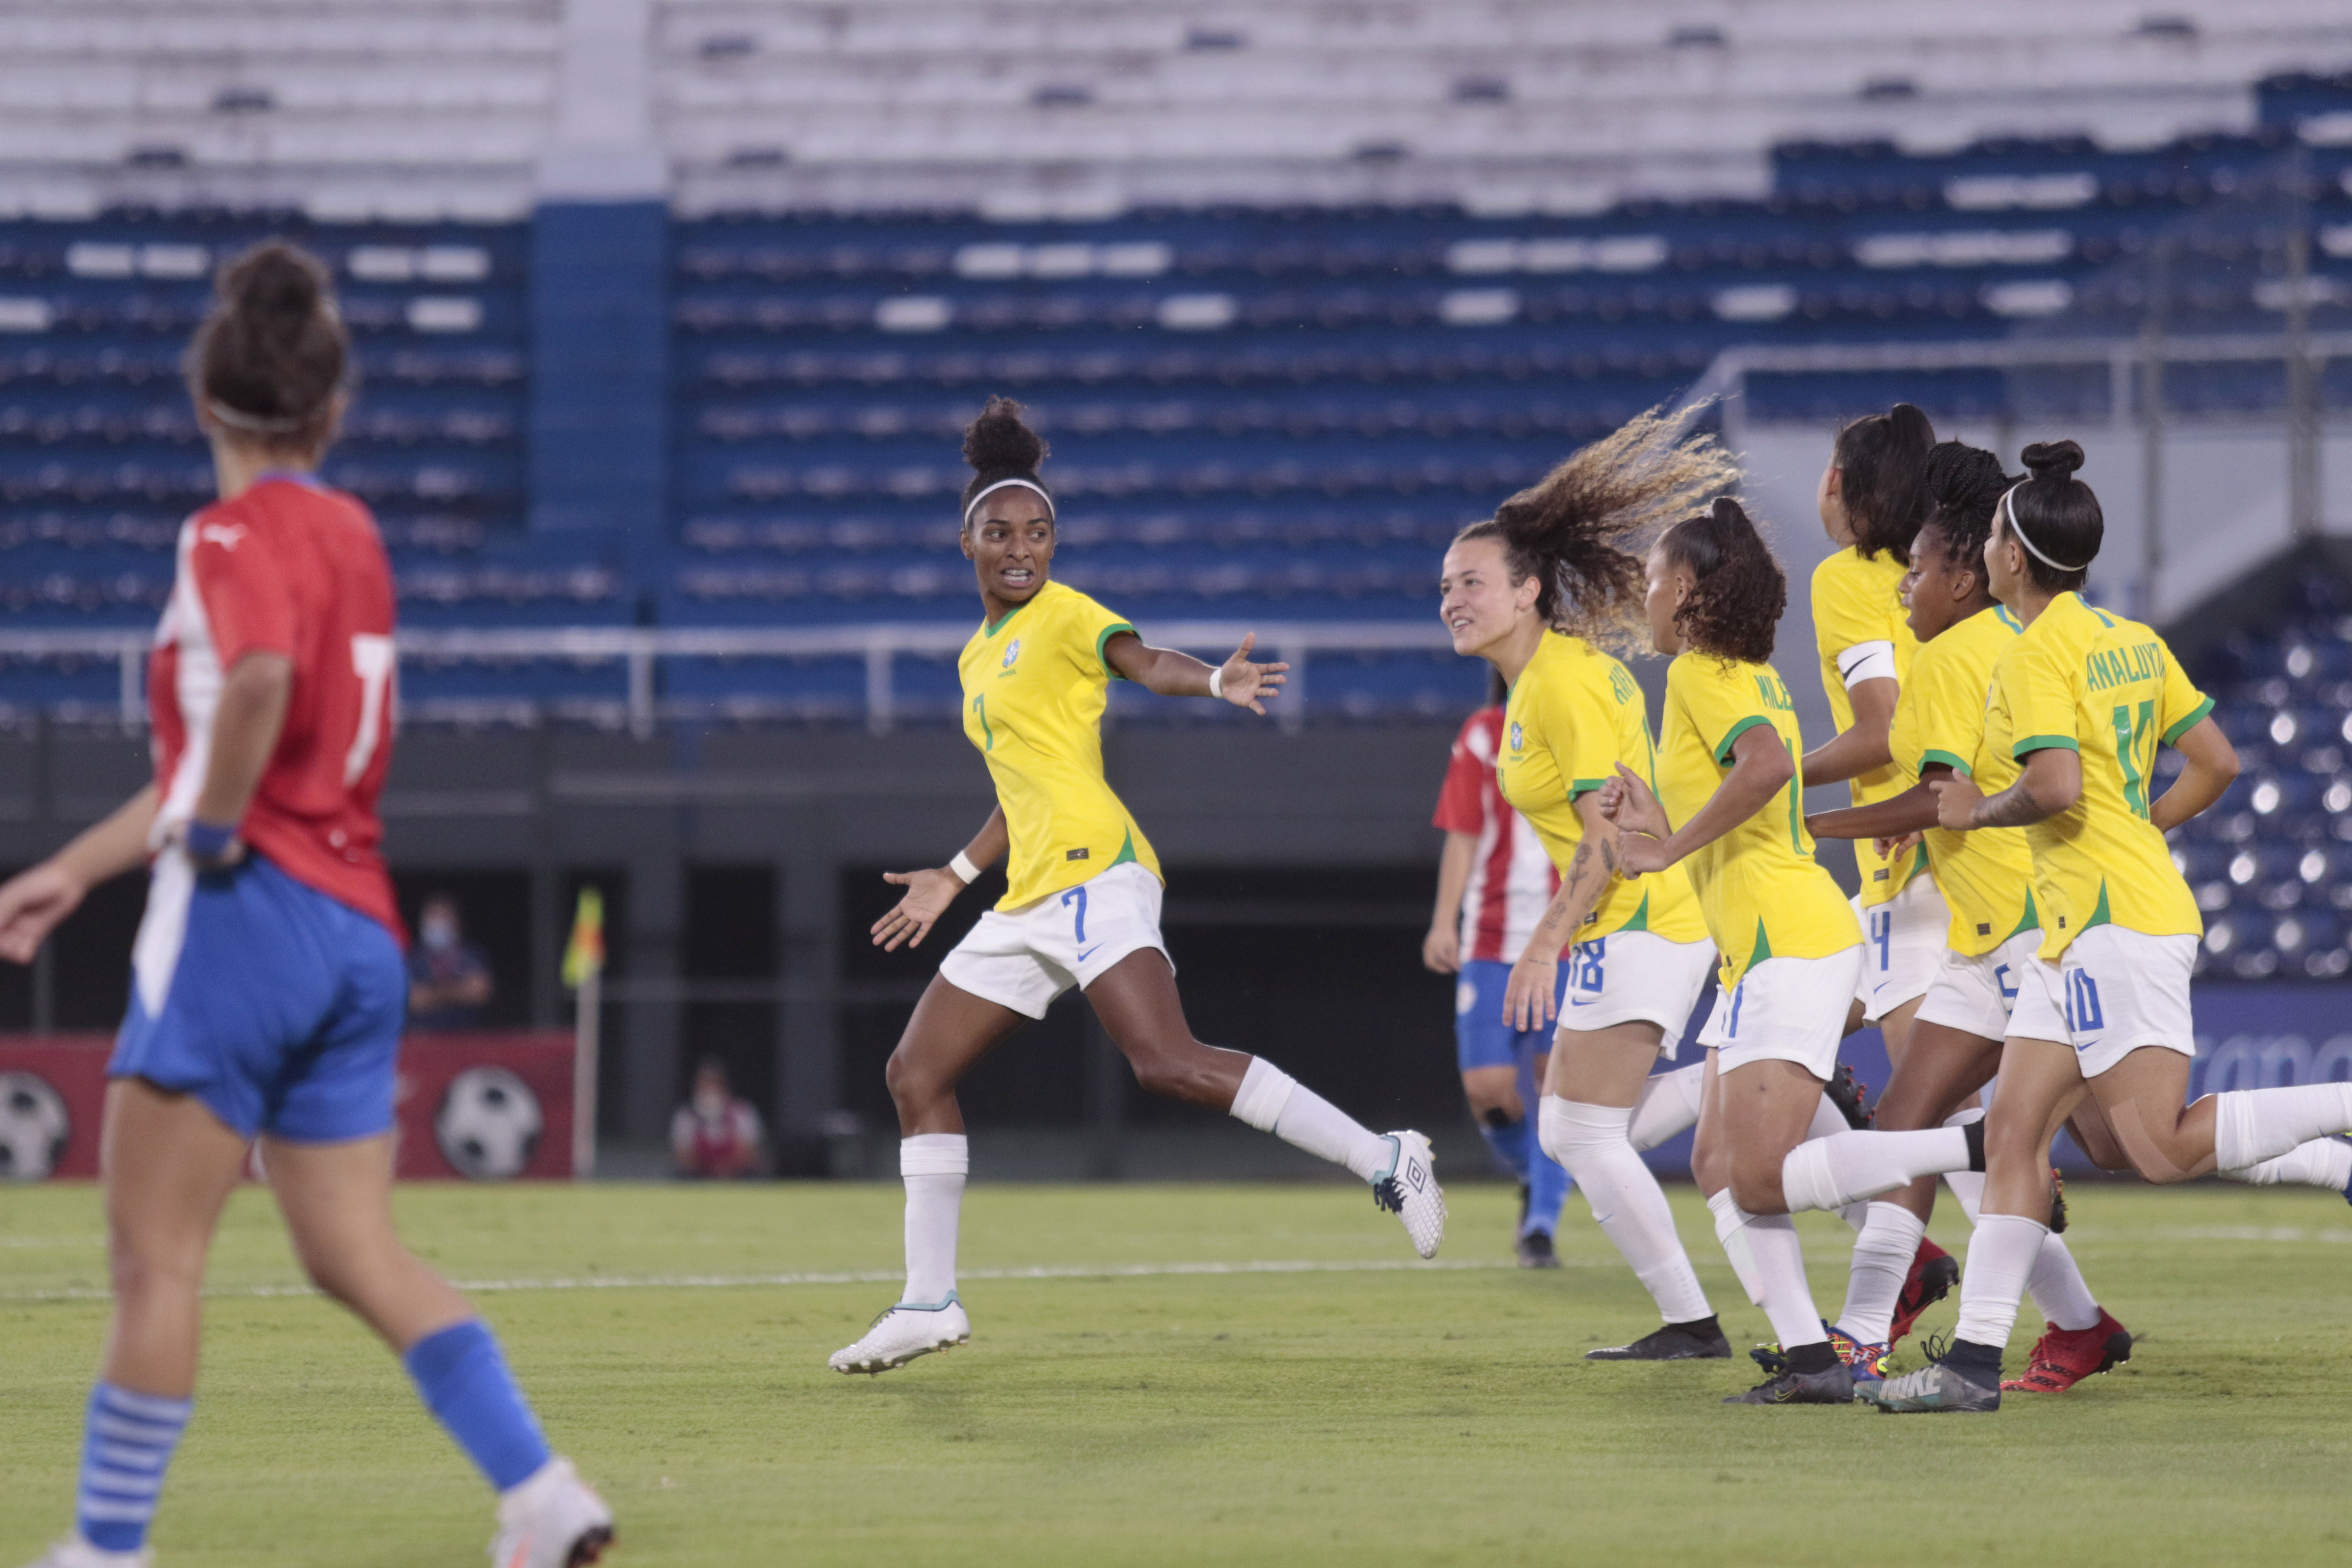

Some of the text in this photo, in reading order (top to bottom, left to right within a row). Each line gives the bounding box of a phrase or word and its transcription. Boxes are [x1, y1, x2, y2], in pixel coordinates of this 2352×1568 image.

[998, 668, 1017, 678] BRASIL
[973, 693, 992, 752] 7
[1061, 886, 1087, 944] 7
[1871, 911, 1890, 971] 4
[1570, 936, 1606, 993] 18
[2065, 968, 2105, 1032] 10
